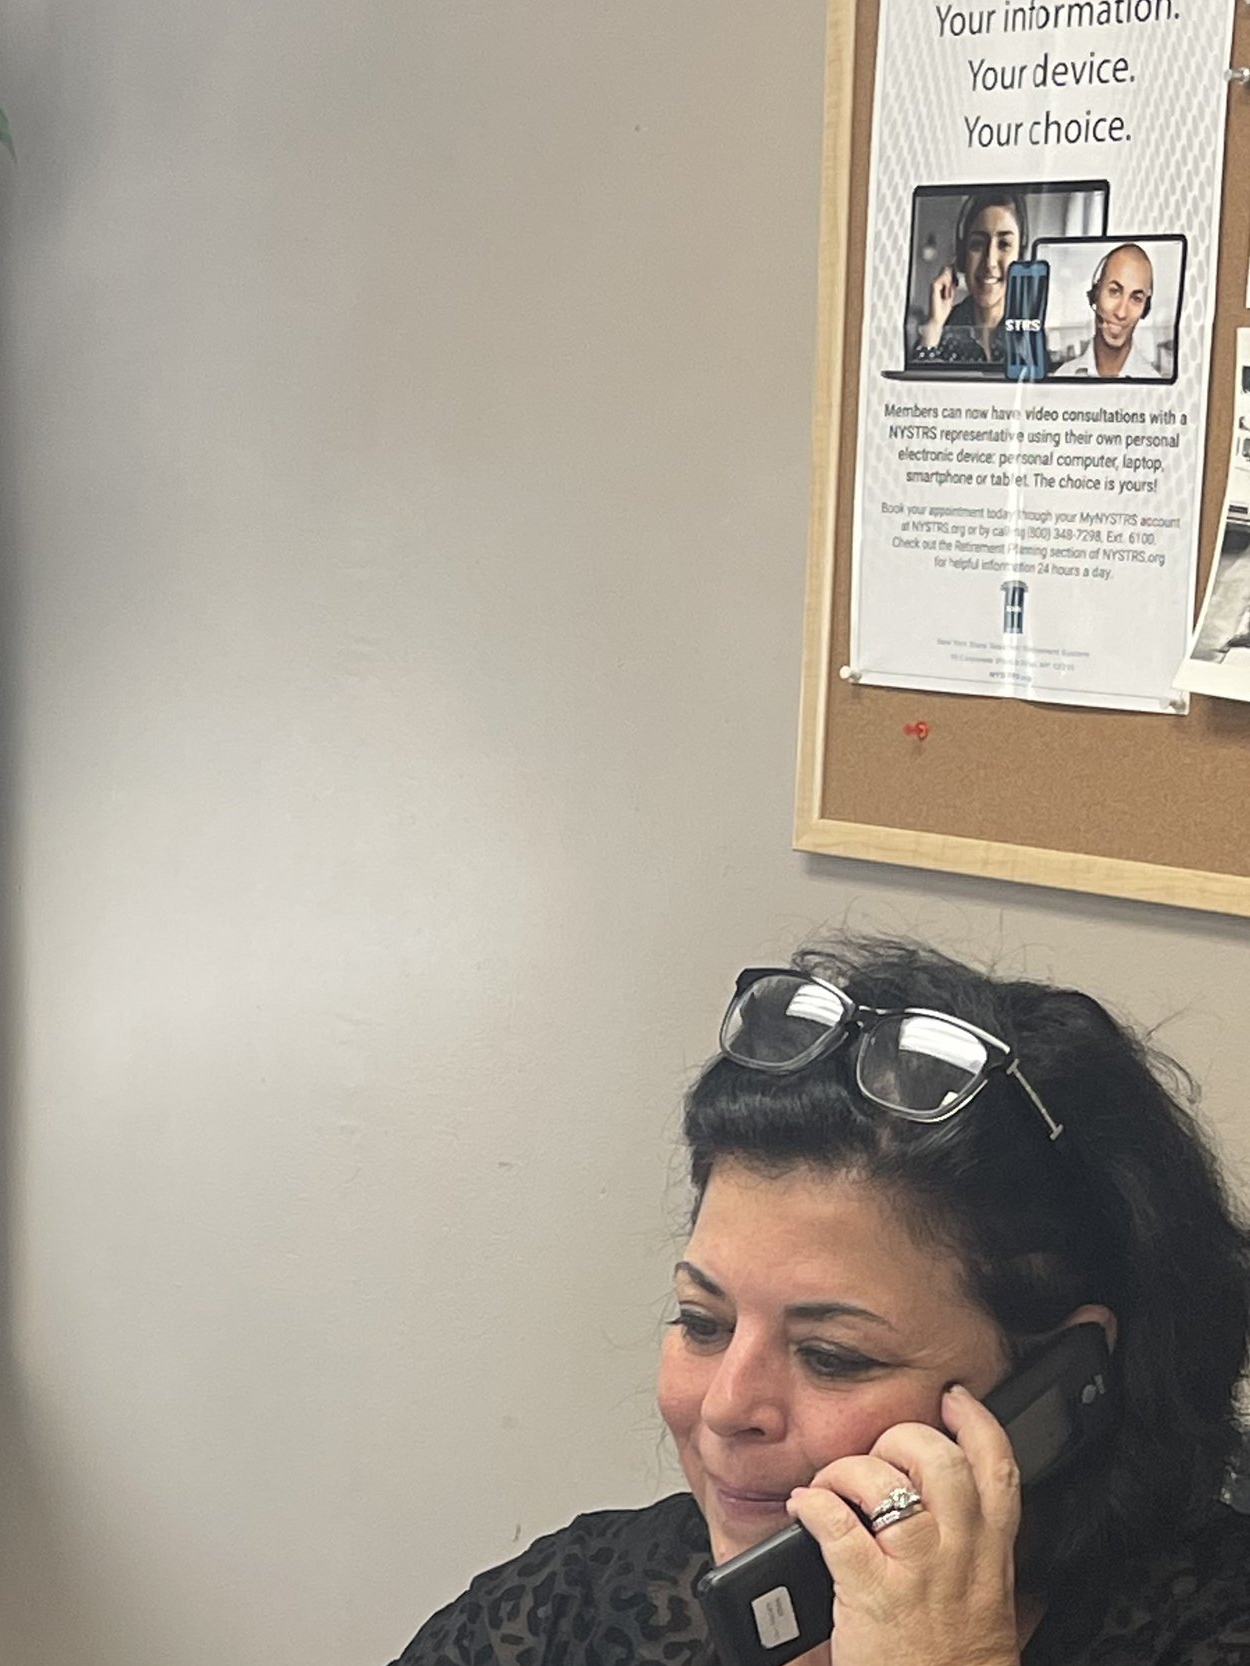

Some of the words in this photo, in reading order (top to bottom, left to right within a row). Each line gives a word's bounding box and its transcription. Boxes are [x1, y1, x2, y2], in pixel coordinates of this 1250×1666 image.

[936, 4, 996, 37] Your
[1003, 0, 1180, 33] information.
[968, 59, 1027, 92] Your
[1032, 53, 1136, 87] device.
[964, 116, 1023, 148] Your
[1029, 110, 1132, 146] choice.
[884, 403, 939, 419] Members
[941, 407, 962, 419] can
[965, 408, 989, 420] now
[1025, 406, 1059, 422] video
[1062, 408, 1146, 424] consultations
[1149, 409, 1176, 426] with
[1180, 413, 1188, 426] a
[888, 424, 938, 440] NYSTRS
[940, 429, 1025, 444] representative
[1027, 430, 1061, 448] using
[1065, 429, 1093, 445] their
[1096, 433, 1122, 446] own
[1125, 433, 1180, 450] personal
[898, 447, 954, 462] electronic
[906, 469, 973, 487] smartphone
[976, 473, 988, 486] or
[1033, 473, 1056, 488] The
[1058, 474, 1101, 490] choice
[1104, 476, 1115, 491] is
[1118, 478, 1158, 495] yours!
